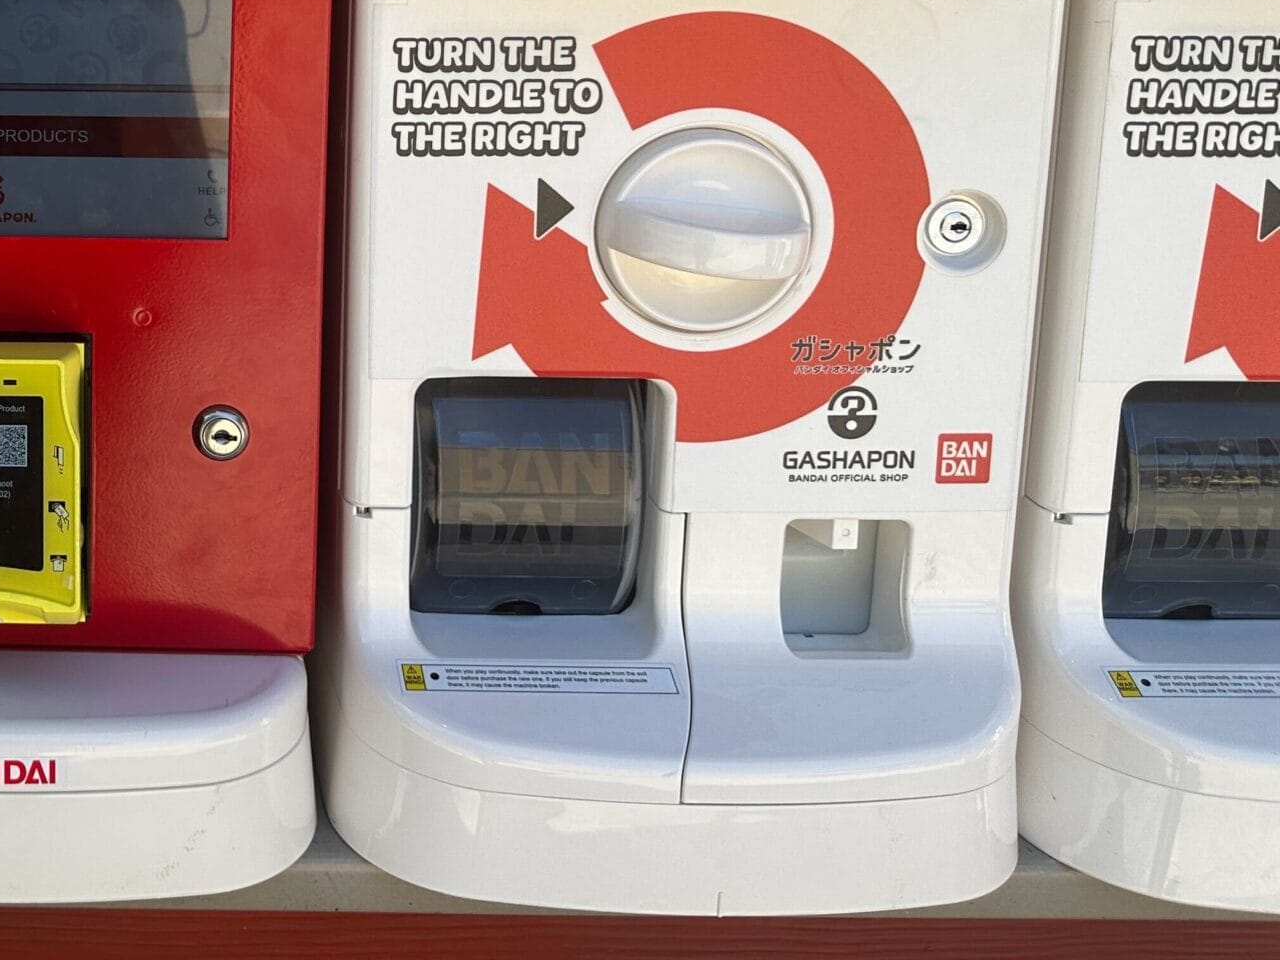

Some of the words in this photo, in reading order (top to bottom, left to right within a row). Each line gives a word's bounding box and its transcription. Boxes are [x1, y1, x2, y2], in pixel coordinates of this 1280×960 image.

[1131, 35, 1234, 72] TURN
[1126, 78, 1280, 115] HANDLE
[1123, 121, 1199, 157] THE
[198, 186, 225, 196] HELP
[791, 335, 921, 361] ガシャポン
[942, 441, 987, 458] BAN
[783, 450, 915, 469] GASHAPON
[940, 459, 977, 477] DAI
[788, 474, 827, 482] BANDAI
[831, 474, 876, 482] OFFICIAL
[879, 474, 908, 482] SHOP
